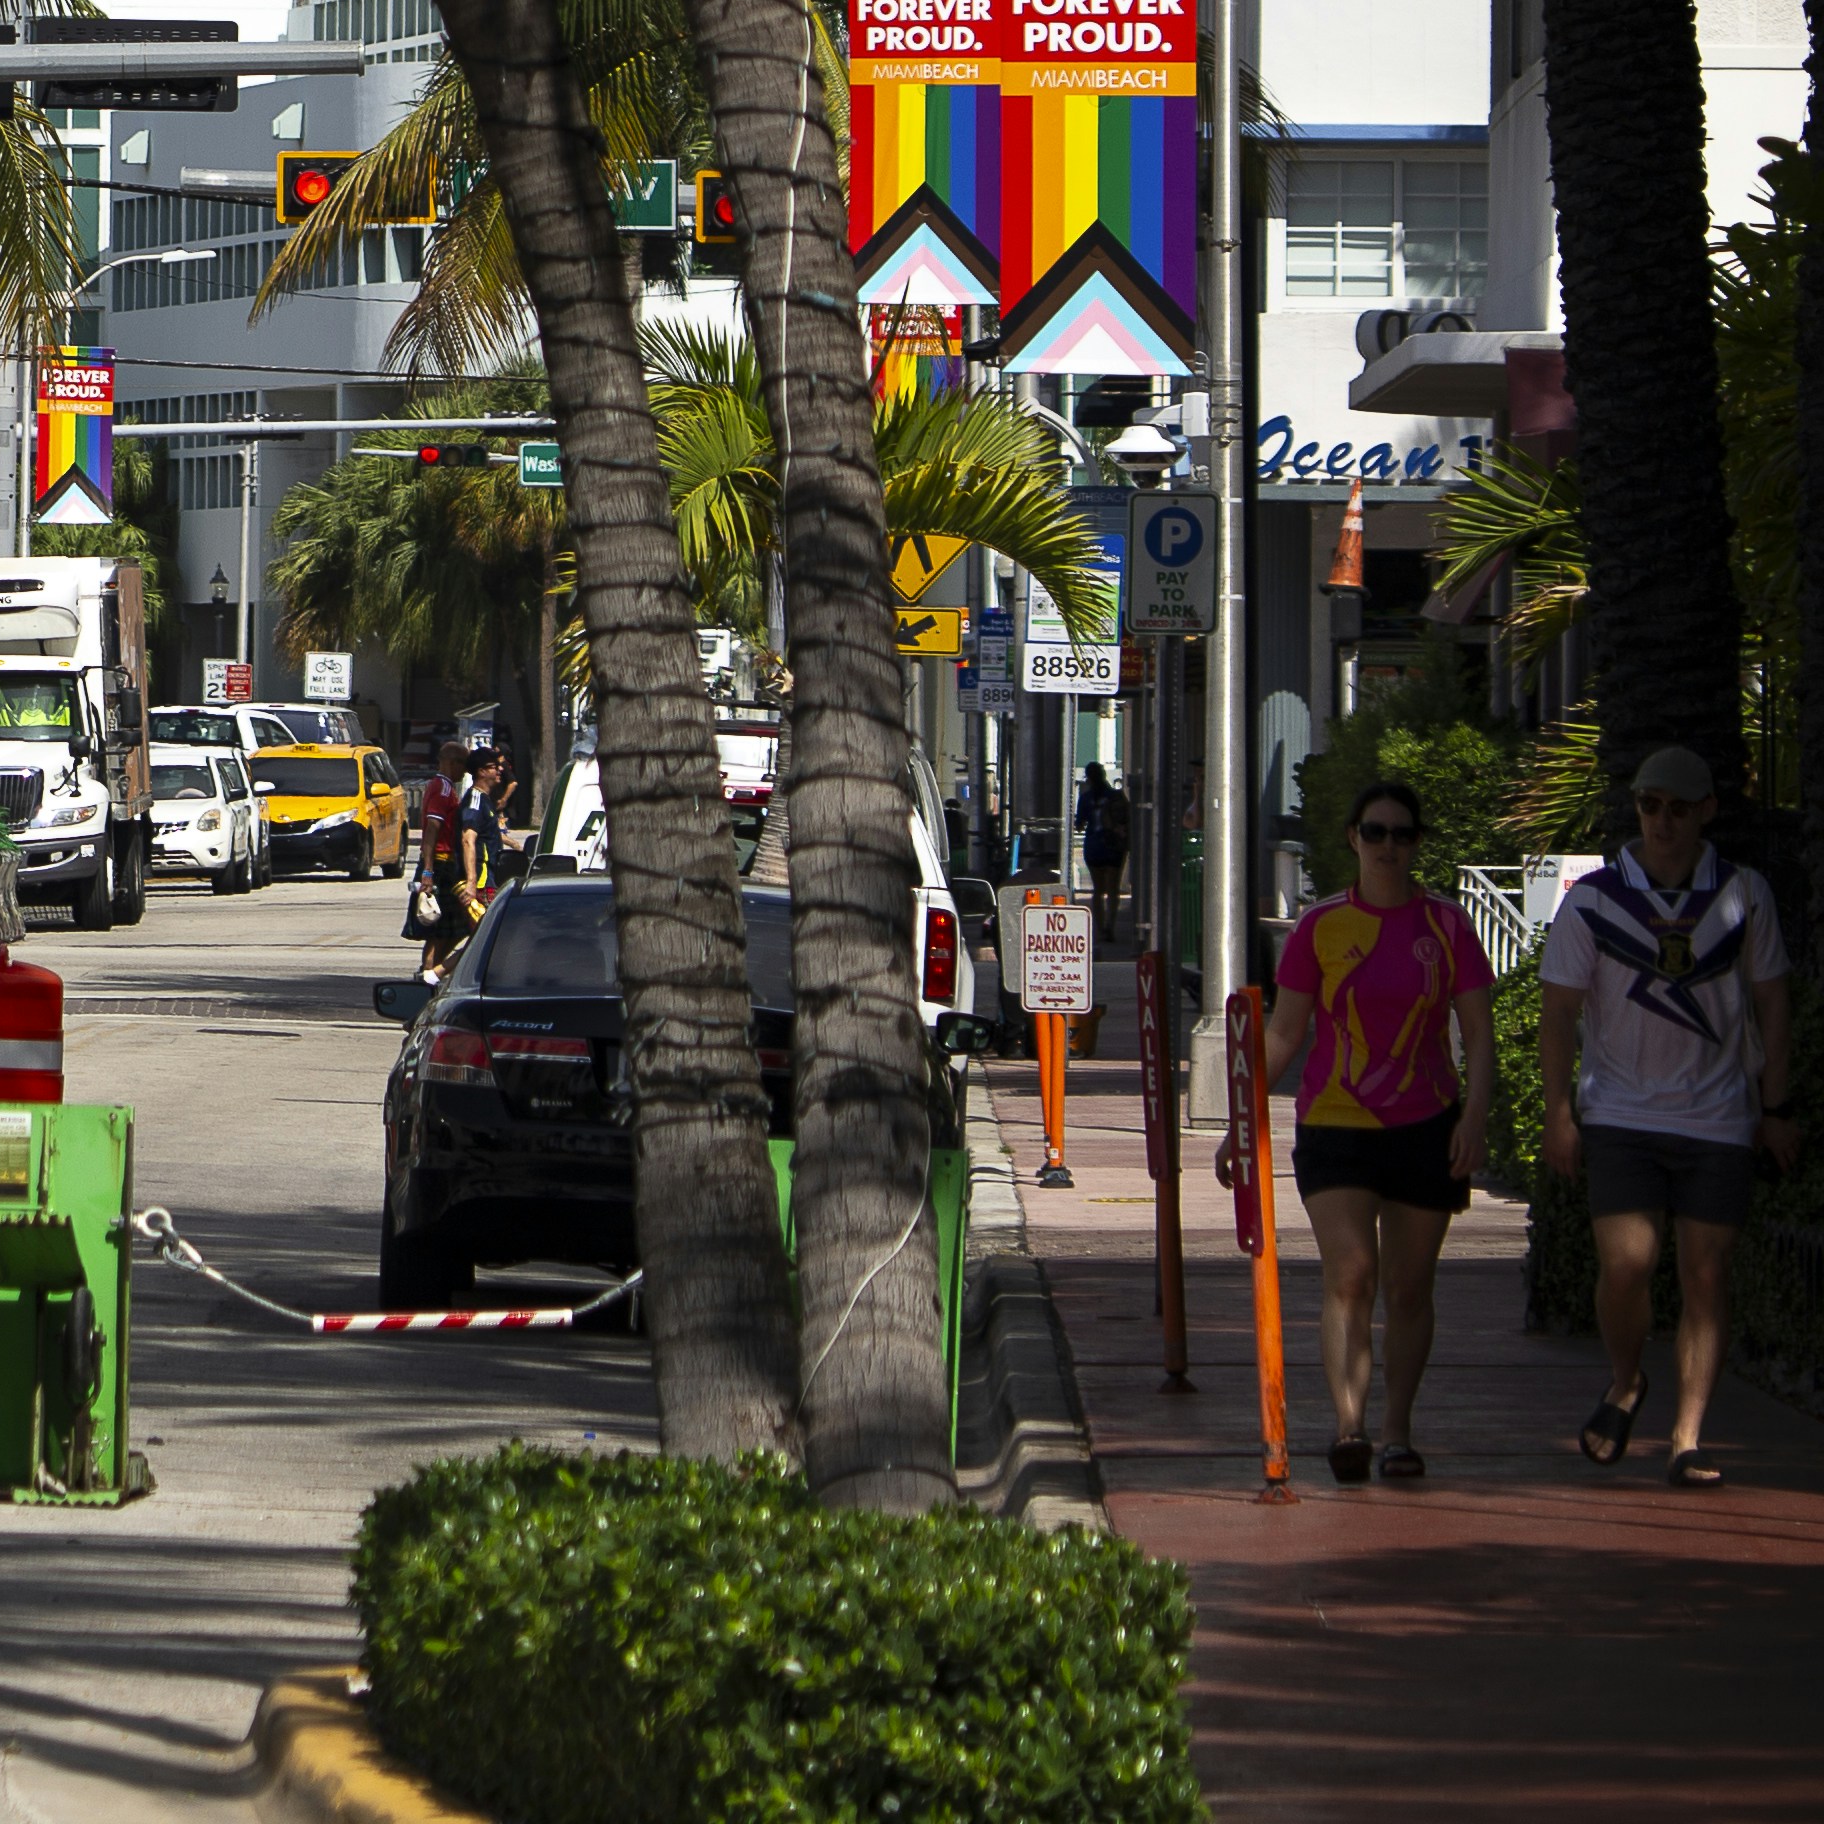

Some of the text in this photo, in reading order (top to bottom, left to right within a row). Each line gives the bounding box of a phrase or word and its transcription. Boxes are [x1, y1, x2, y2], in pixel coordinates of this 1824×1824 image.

[866, 26, 983, 51] PROUD.
[1024, 21, 1172, 53] PROUD.
[872, 63, 979, 80] MIAMIBEACH
[1031, 69, 1167, 89] MIAMIBEACH
[1257, 415, 1493, 478] Ocean 1
[525, 456, 561, 472] Wash
[1156, 572, 1189, 585] PAY
[1161, 588, 1184, 602] TO
[1149, 604, 1195, 618] PARK
[1032, 655, 1111, 679] 88526
[331, 676, 343, 684] USE
[329, 686, 346, 694] LANE
[982, 688, 1014, 703] 889
[1046, 913, 1067, 932] NO
[1027, 934, 1085, 954] PARKING
[490, 1020, 554, 1030] Accord
[1139, 975, 1157, 1121] VALET
[1230, 1014, 1252, 1185] VALET
